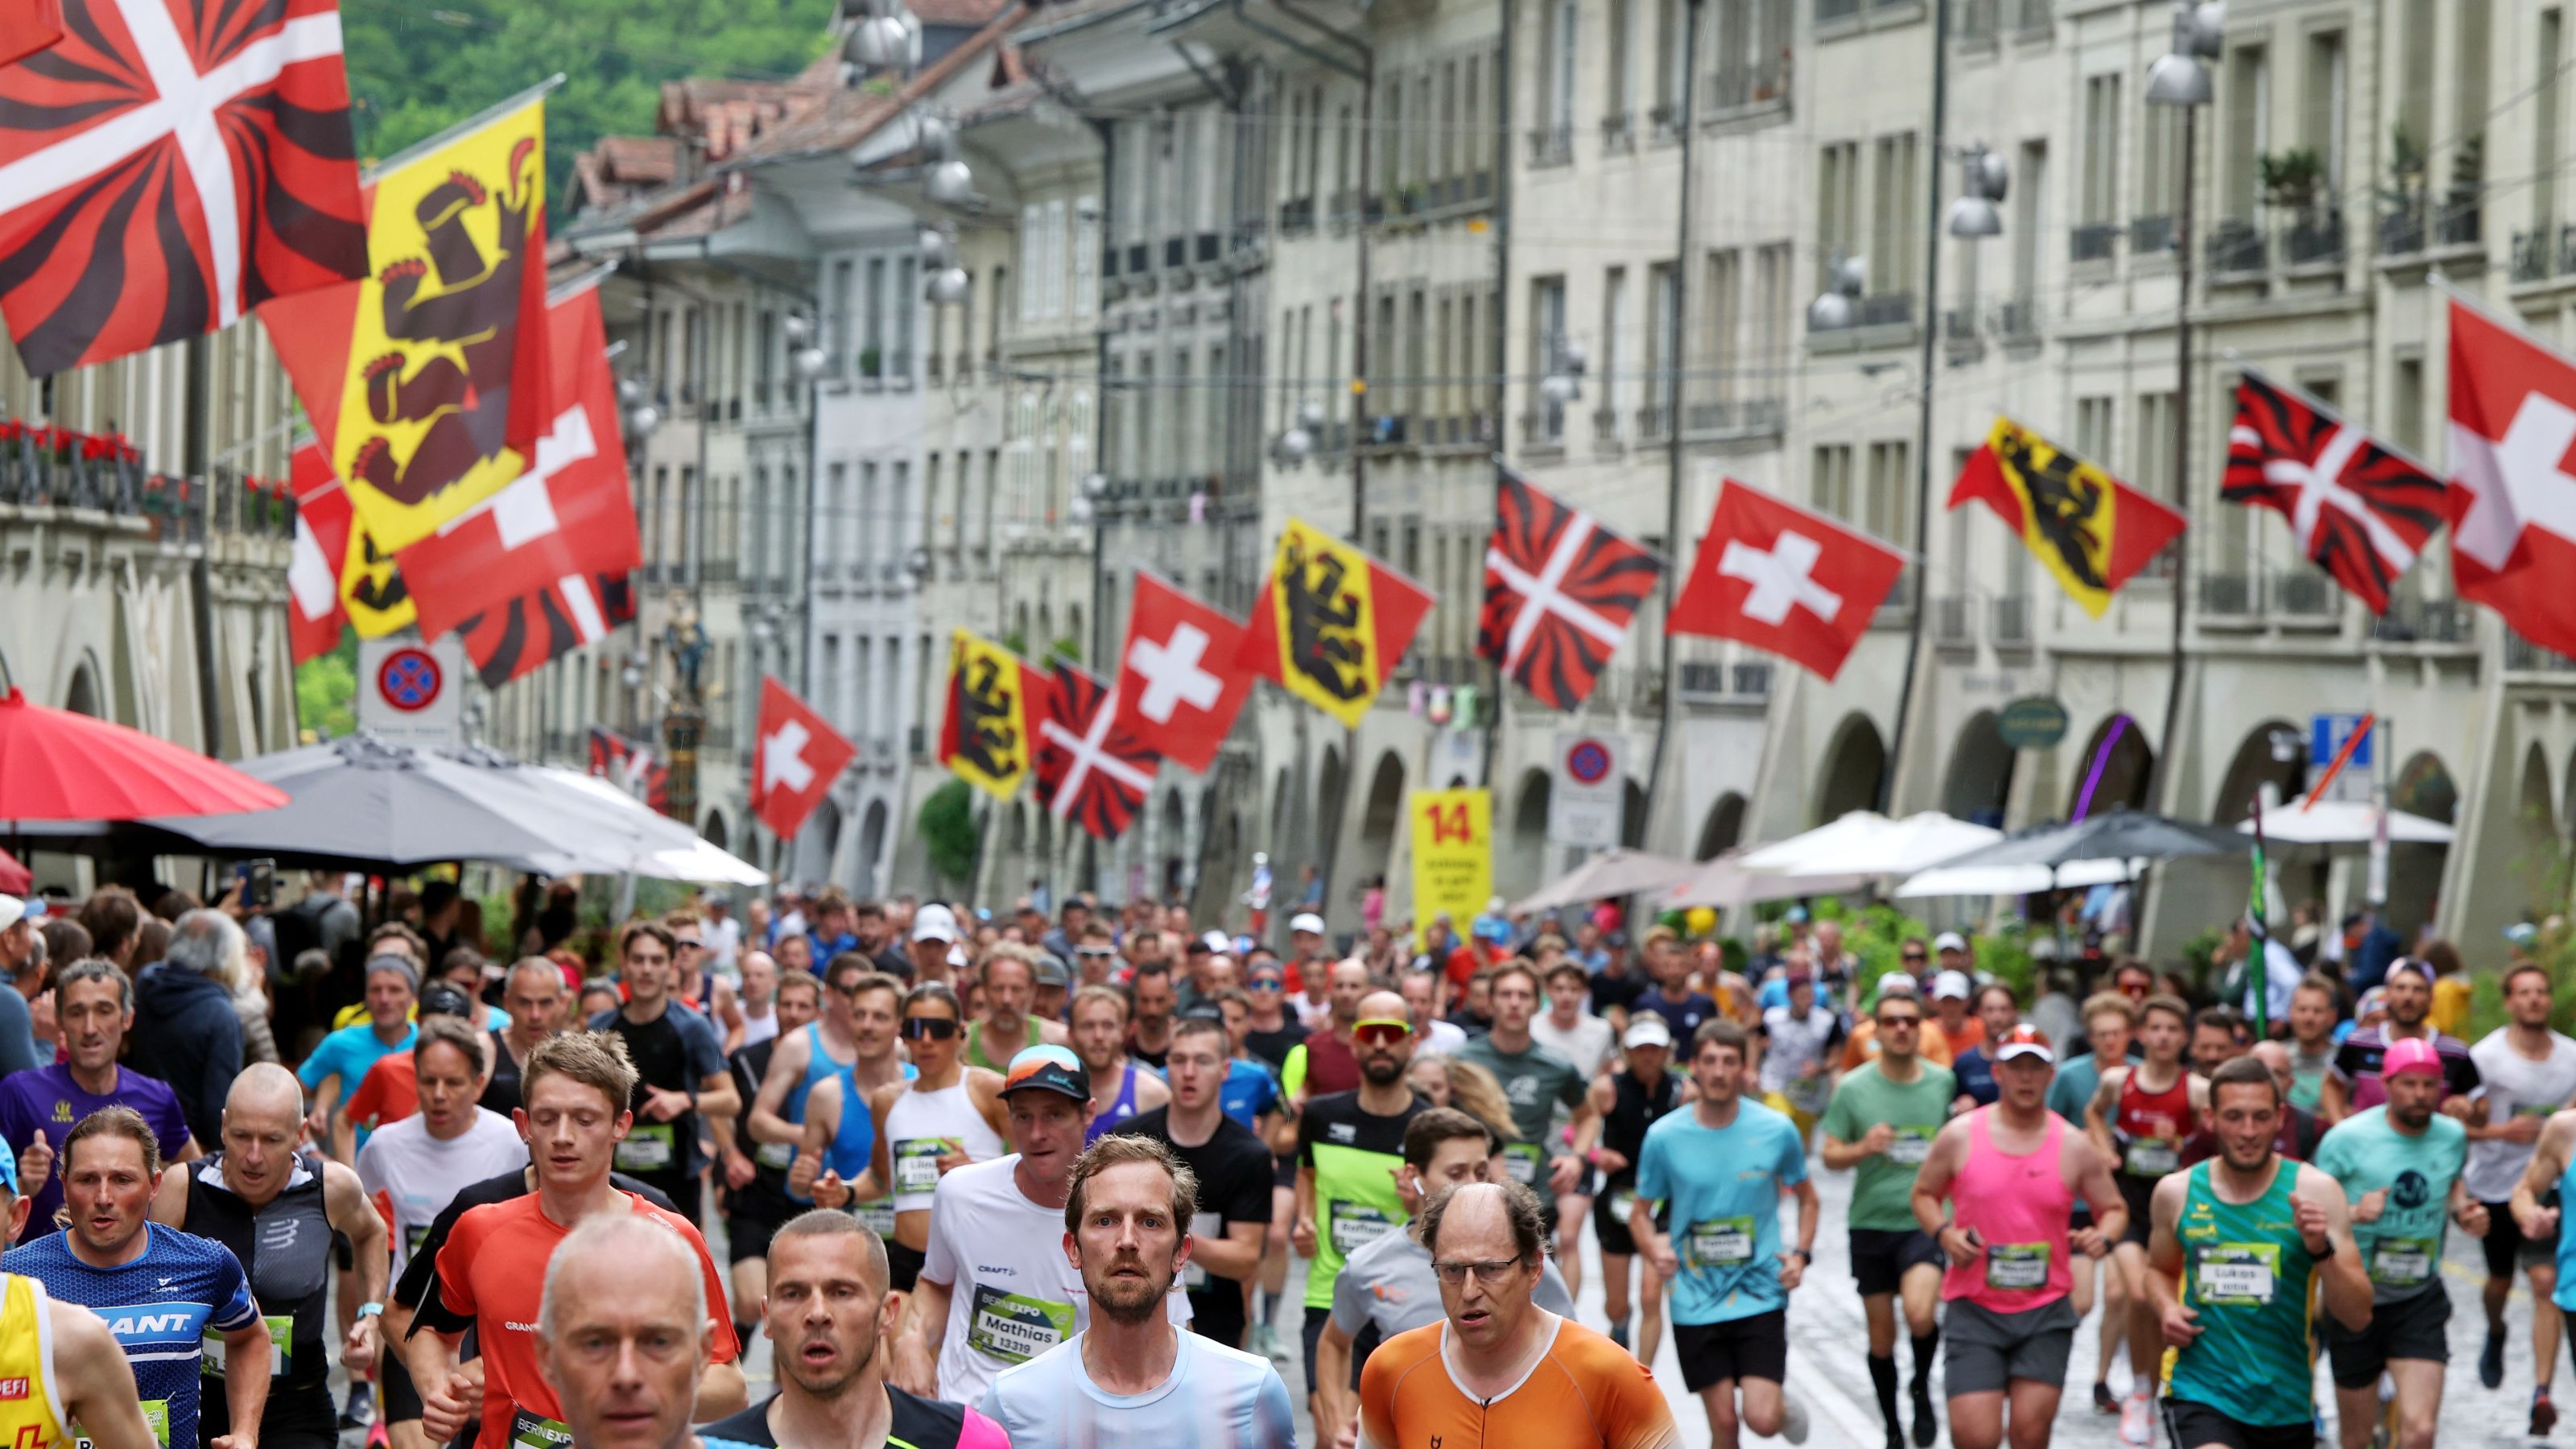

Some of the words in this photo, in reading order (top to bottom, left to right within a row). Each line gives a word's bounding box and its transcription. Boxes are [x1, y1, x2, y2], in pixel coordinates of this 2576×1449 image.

[1425, 802, 1472, 845] 14
[978, 1265, 1007, 1275] CRAFT
[981, 1294, 1041, 1317] BERNEXPO
[986, 1316, 1052, 1343] Mathias
[1000, 1337, 1030, 1354] 13319
[0, 1378, 27, 1396] EFI
[517, 1418, 573, 1444] BERNEXP
